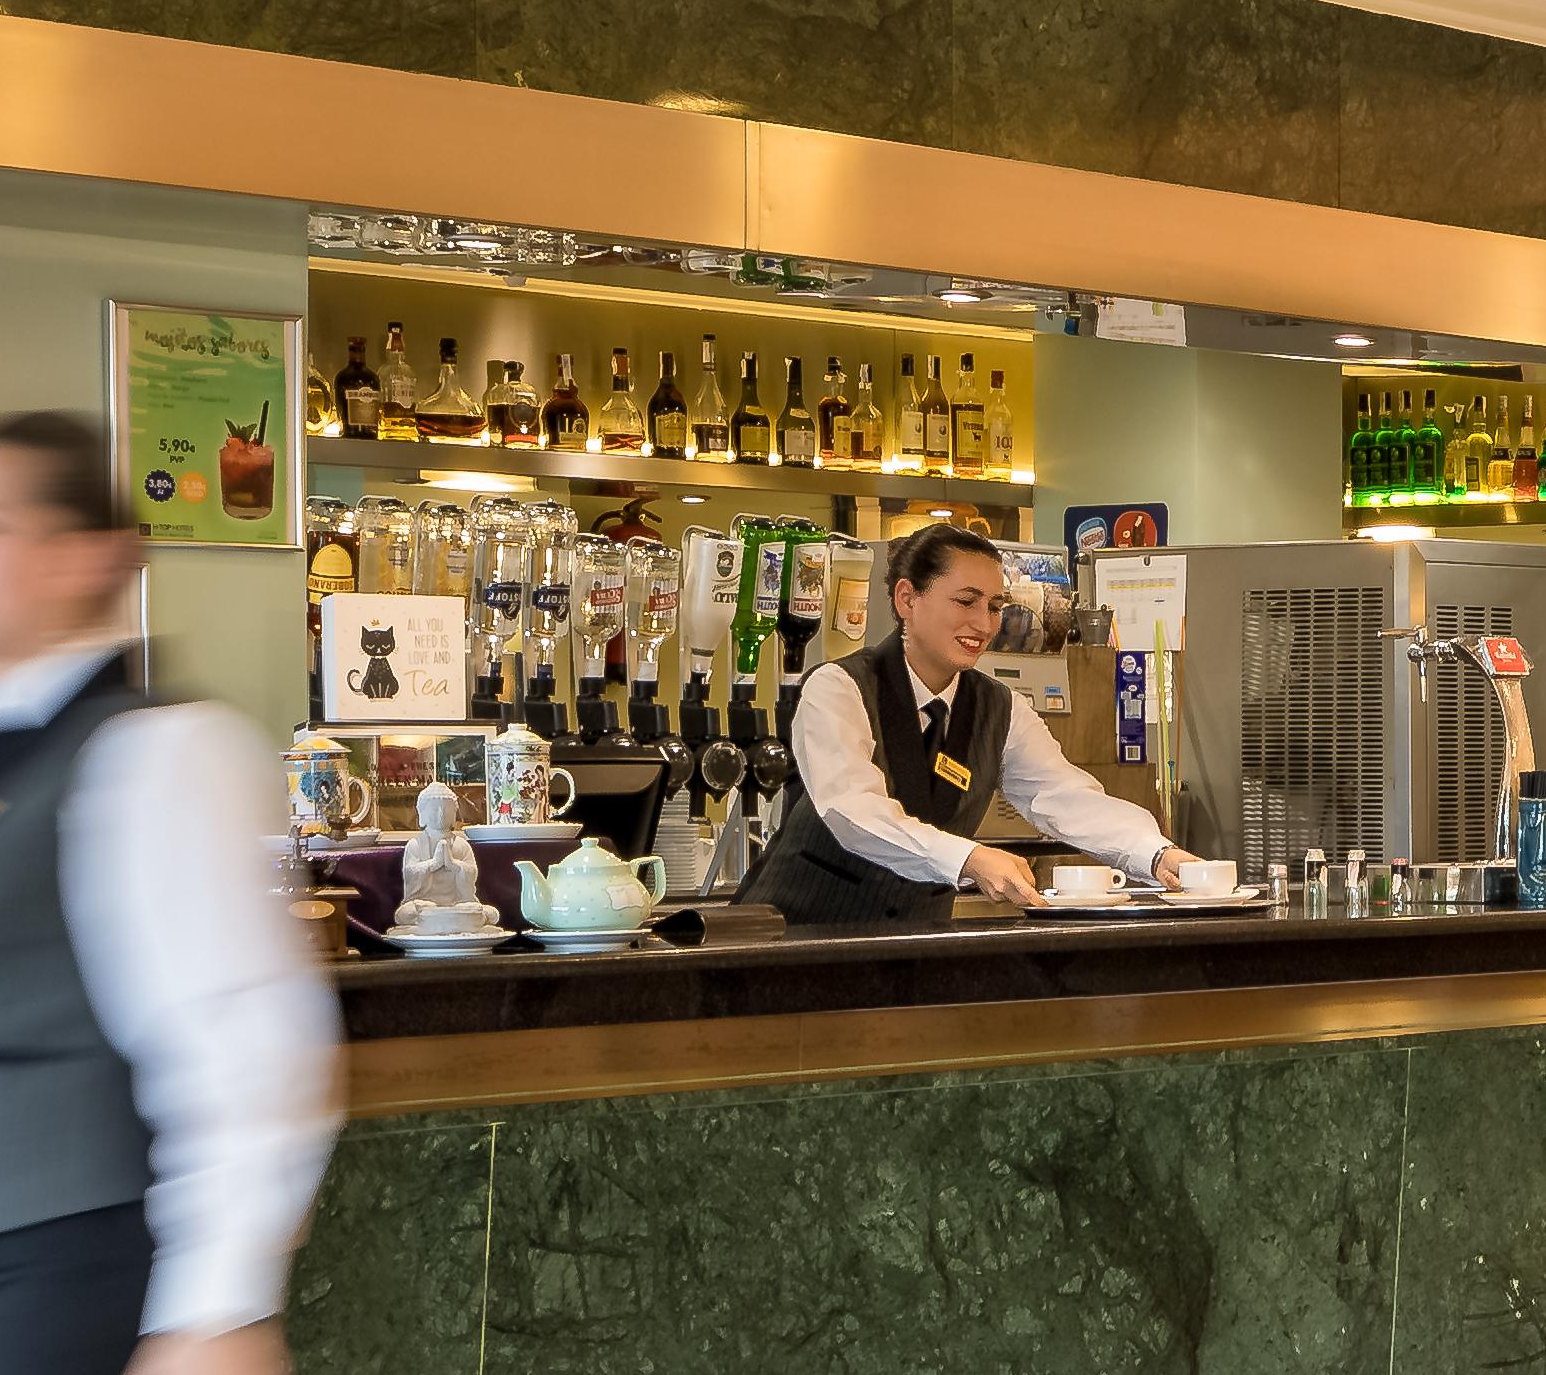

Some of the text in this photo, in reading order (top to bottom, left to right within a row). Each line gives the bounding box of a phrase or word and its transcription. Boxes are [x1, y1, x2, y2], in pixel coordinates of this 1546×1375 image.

[407, 618, 443, 633] ALL YOU
[414, 635, 450, 647] NEED IS
[408, 651, 451, 664] LOVE AND
[404, 669, 450, 697] Tea
